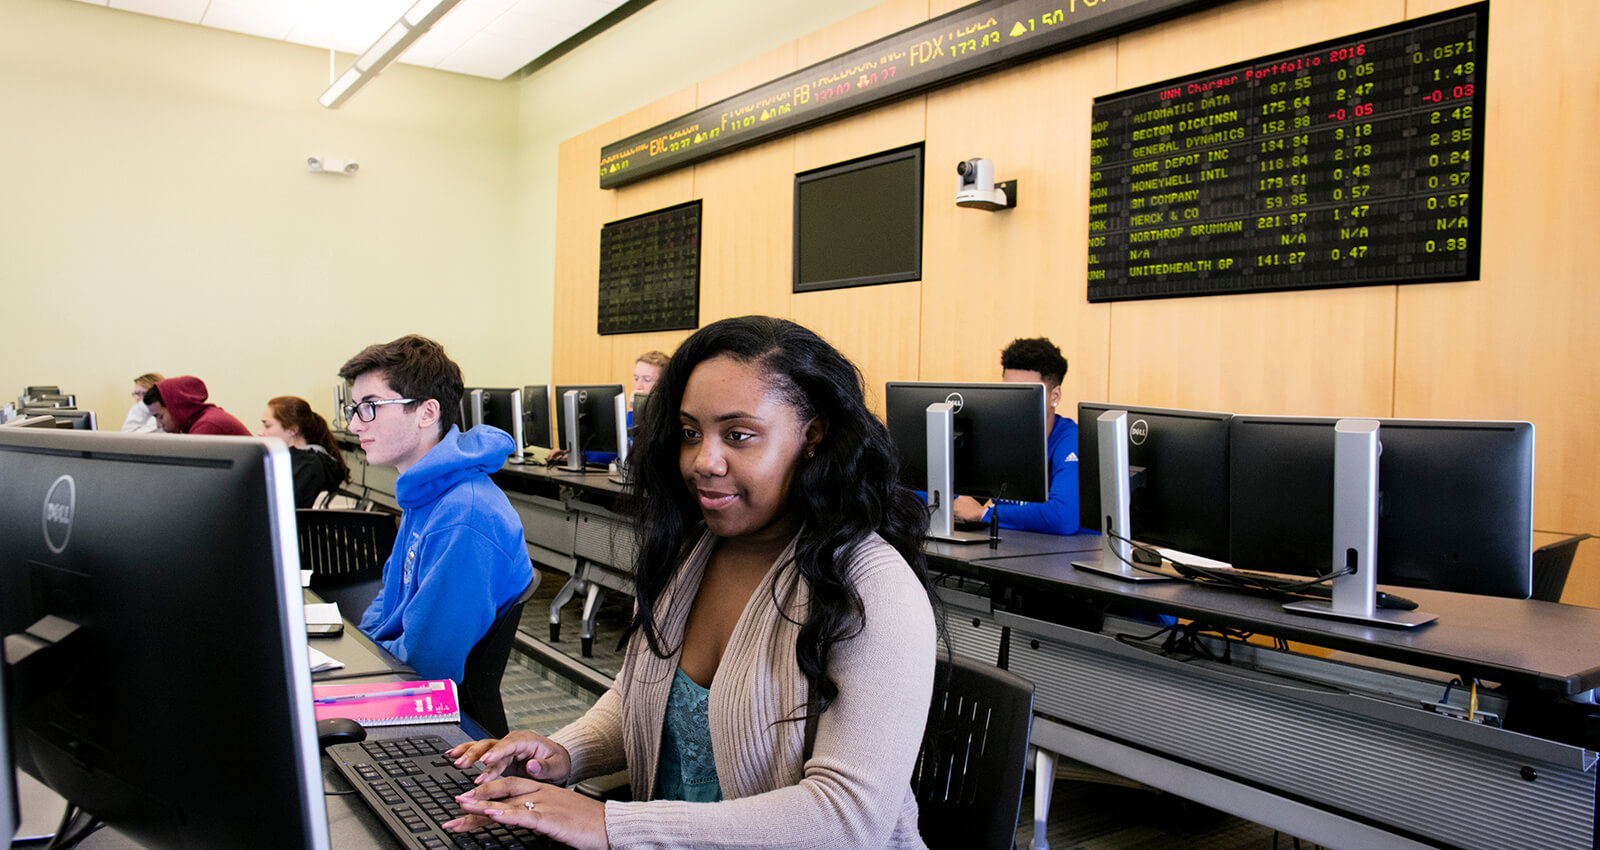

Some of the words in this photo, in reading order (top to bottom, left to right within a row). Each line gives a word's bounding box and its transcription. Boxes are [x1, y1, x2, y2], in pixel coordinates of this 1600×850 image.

[909, 35, 945, 67] FDX
[1160, 88, 1181, 101] UNH
[1187, 75, 1238, 95] Charger
[1245, 57, 1321, 81] Portfolio
[1329, 44, 1366, 63] 2016
[793, 84, 810, 106] FB
[1132, 123, 1174, 141] BECTON
[1179, 110, 1238, 132] DICKINSN
[1262, 96, 1310, 116] 175.64
[1336, 83, 1374, 101] 2.47
[1433, 62, 1475, 81] 1.43
[1133, 102, 1194, 124] AUTOMATIC
[1201, 94, 1231, 110] DATA
[1270, 76, 1312, 95] 87.55
[1337, 62, 1374, 81] 0.05
[1413, 41, 1474, 64] 0.0571
[649, 135, 668, 157] EXC
[721, 113, 728, 131] F
[1089, 172, 1102, 182] HD
[1131, 161, 1159, 175] HOME
[1165, 154, 1200, 169] DEPOT
[1208, 149, 1229, 162] INC
[1261, 134, 1309, 153] 134.34
[1335, 123, 1372, 140] 3.18
[1430, 106, 1473, 125] 2.42
[1132, 141, 1179, 158] GENERAL
[1186, 127, 1245, 148] DYNAMICS
[1262, 115, 1311, 134] 152.38
[1328, 103, 1373, 121] -0.05
[1422, 84, 1474, 103] -0.03
[1089, 187, 1108, 199] HON
[1131, 173, 1192, 192] HONEYWELL
[1201, 168, 1229, 182] INTL
[1260, 154, 1308, 172] 118.84
[1334, 144, 1372, 161] 2.73
[1429, 128, 1472, 146] 2.35
[1089, 203, 1107, 215] MMM
[1131, 198, 1145, 210] 3M
[1151, 189, 1199, 207] COMPANY
[1260, 174, 1307, 191] 179.61
[1333, 164, 1370, 180] 0.43
[1429, 149, 1470, 167] 0.24
[1088, 220, 1106, 231] MRK
[1131, 212, 1164, 226] MERCK
[1171, 211, 1178, 220] &
[1184, 208, 1199, 219] CO
[1266, 193, 1307, 209] 59.35
[1333, 185, 1370, 200] 0.57
[1428, 172, 1470, 189] 0.97
[1088, 237, 1106, 247] NOC
[1130, 227, 1184, 243] NORTHROP
[1190, 220, 1243, 236] GRUMMAN
[1257, 212, 1307, 229] 221.97
[1333, 205, 1369, 220] 1.47
[1427, 193, 1469, 210] 0.67
[1087, 255, 1100, 264] UL
[1130, 249, 1150, 260] N/A
[1281, 233, 1307, 246] N/A
[1340, 226, 1369, 240] N/A
[1436, 216, 1468, 231] N/A
[1087, 270, 1105, 280] UNH
[1129, 260, 1212, 277] UNITEDHEALTH
[1218, 258, 1234, 270] GP
[1257, 252, 1306, 267] 141.27
[1331, 246, 1368, 261] 0.47
[1425, 237, 1468, 253] 0.33
[1132, 428, 1146, 436] DELL
